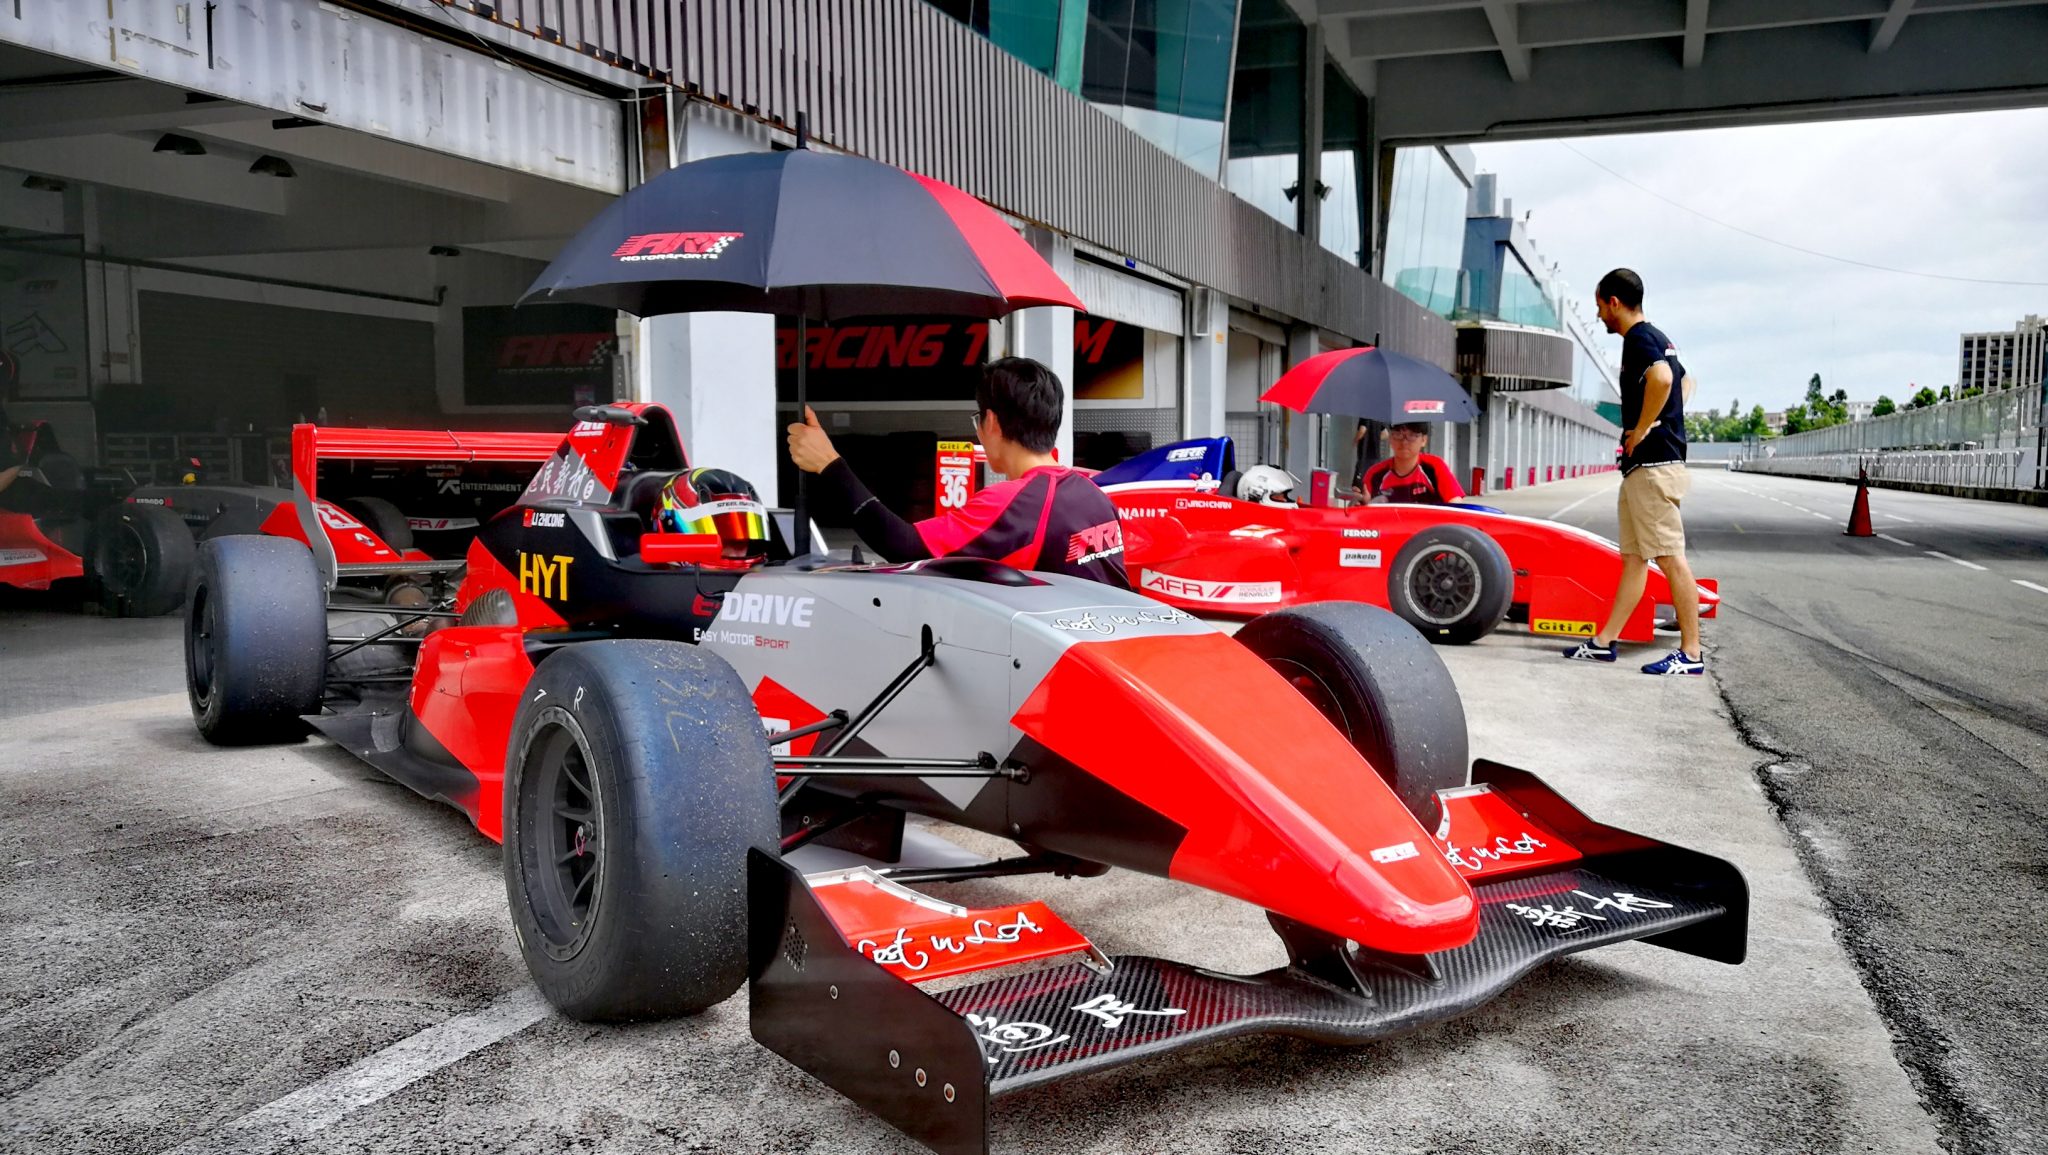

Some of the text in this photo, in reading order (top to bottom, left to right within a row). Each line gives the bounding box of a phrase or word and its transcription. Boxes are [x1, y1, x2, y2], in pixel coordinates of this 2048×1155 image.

[620, 253, 718, 262] MOTORSPORTS
[776, 321, 1116, 369] RACING TM
[461, 482, 522, 492] ENTERTAINMENT
[939, 475, 968, 508] 36
[531, 512, 539, 526] LI
[1118, 507, 1168, 520] NAULT
[407, 519, 432, 529] FR
[1343, 528, 1379, 538] FERODO
[520, 552, 574, 601] HYT
[1147, 576, 1204, 597] AFR
[1537, 621, 1573, 632] Giti
